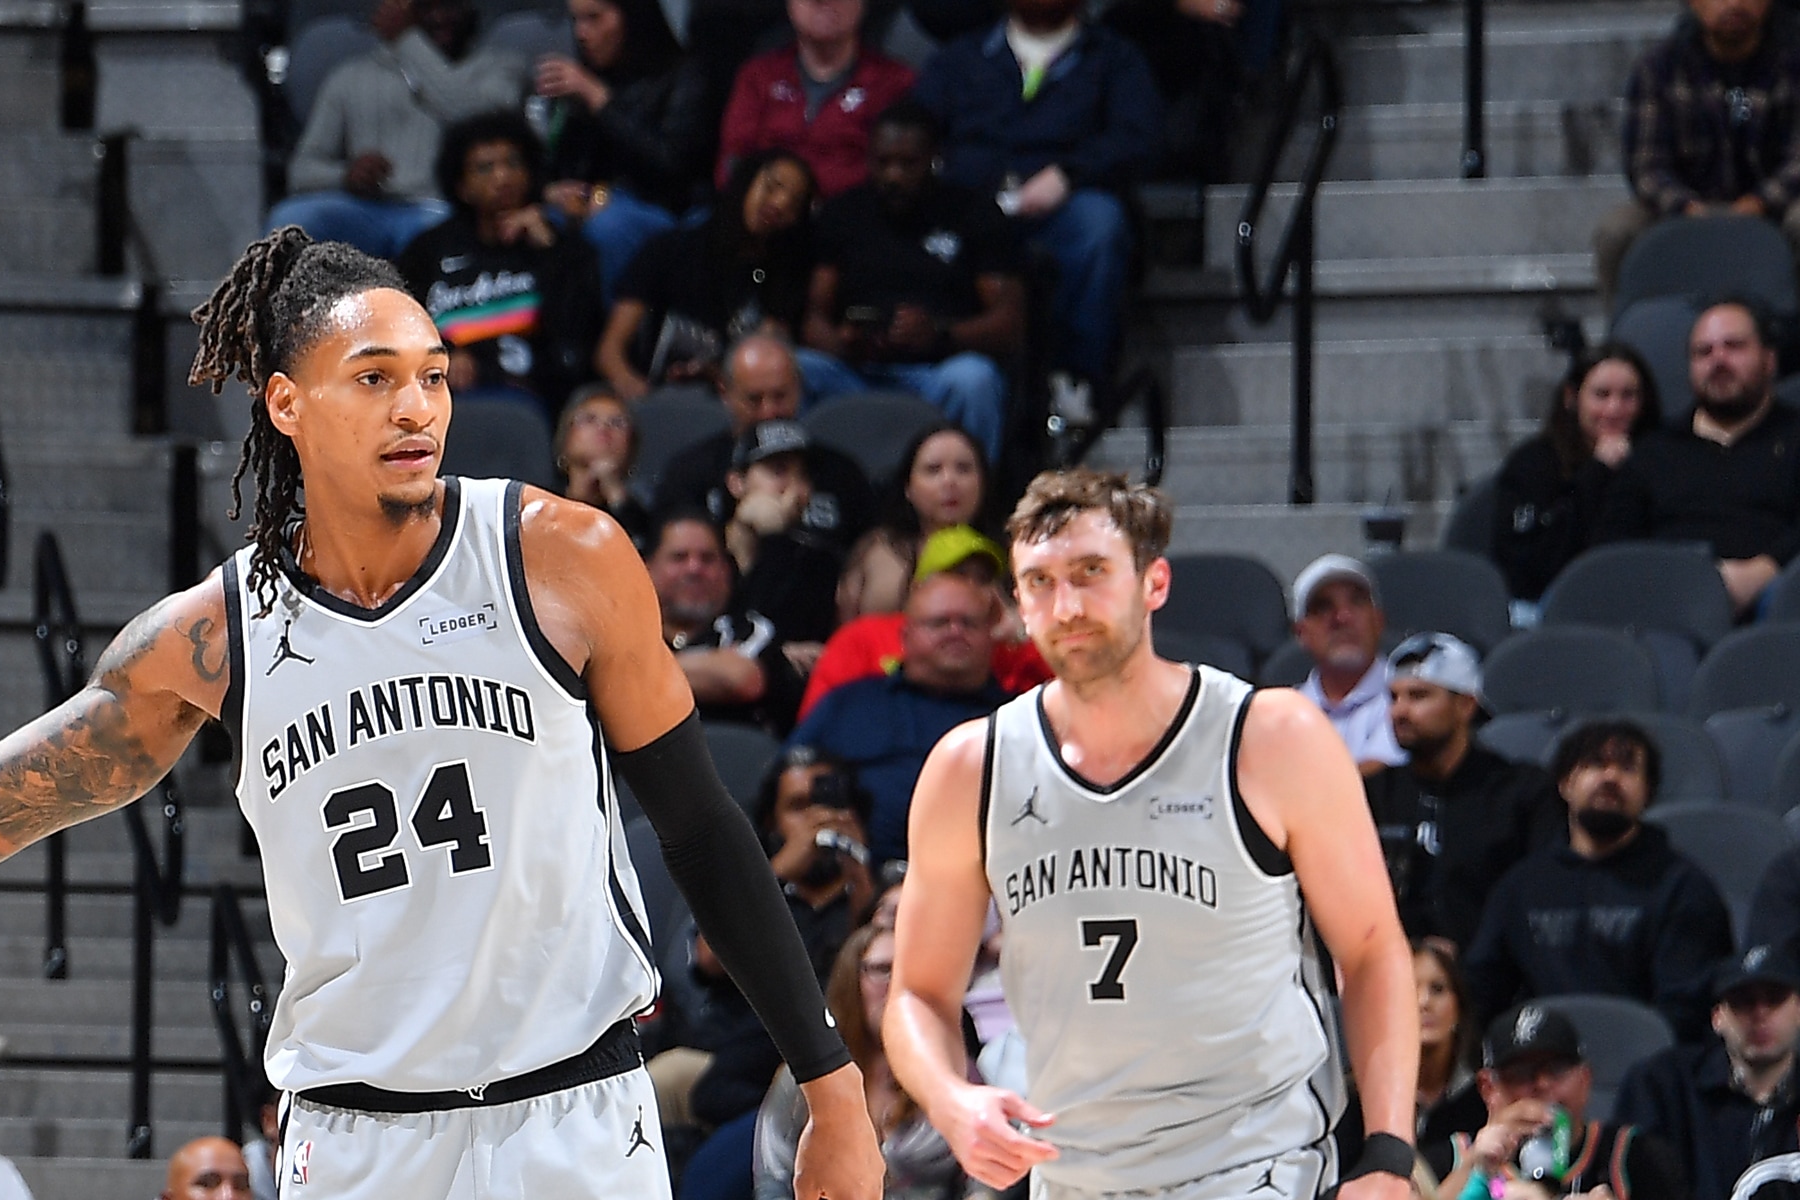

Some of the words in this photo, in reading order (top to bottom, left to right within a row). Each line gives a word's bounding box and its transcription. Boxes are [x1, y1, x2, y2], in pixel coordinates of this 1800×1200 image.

[429, 612, 487, 636] LEDGER
[261, 702, 336, 802] SAN
[348, 675, 537, 747] ANTONIO
[321, 760, 494, 903] 24
[1157, 803, 1205, 815] LEDGER
[1005, 854, 1058, 917] SAN
[1066, 847, 1218, 911] ANTONIO
[1080, 918, 1140, 1002] 7
